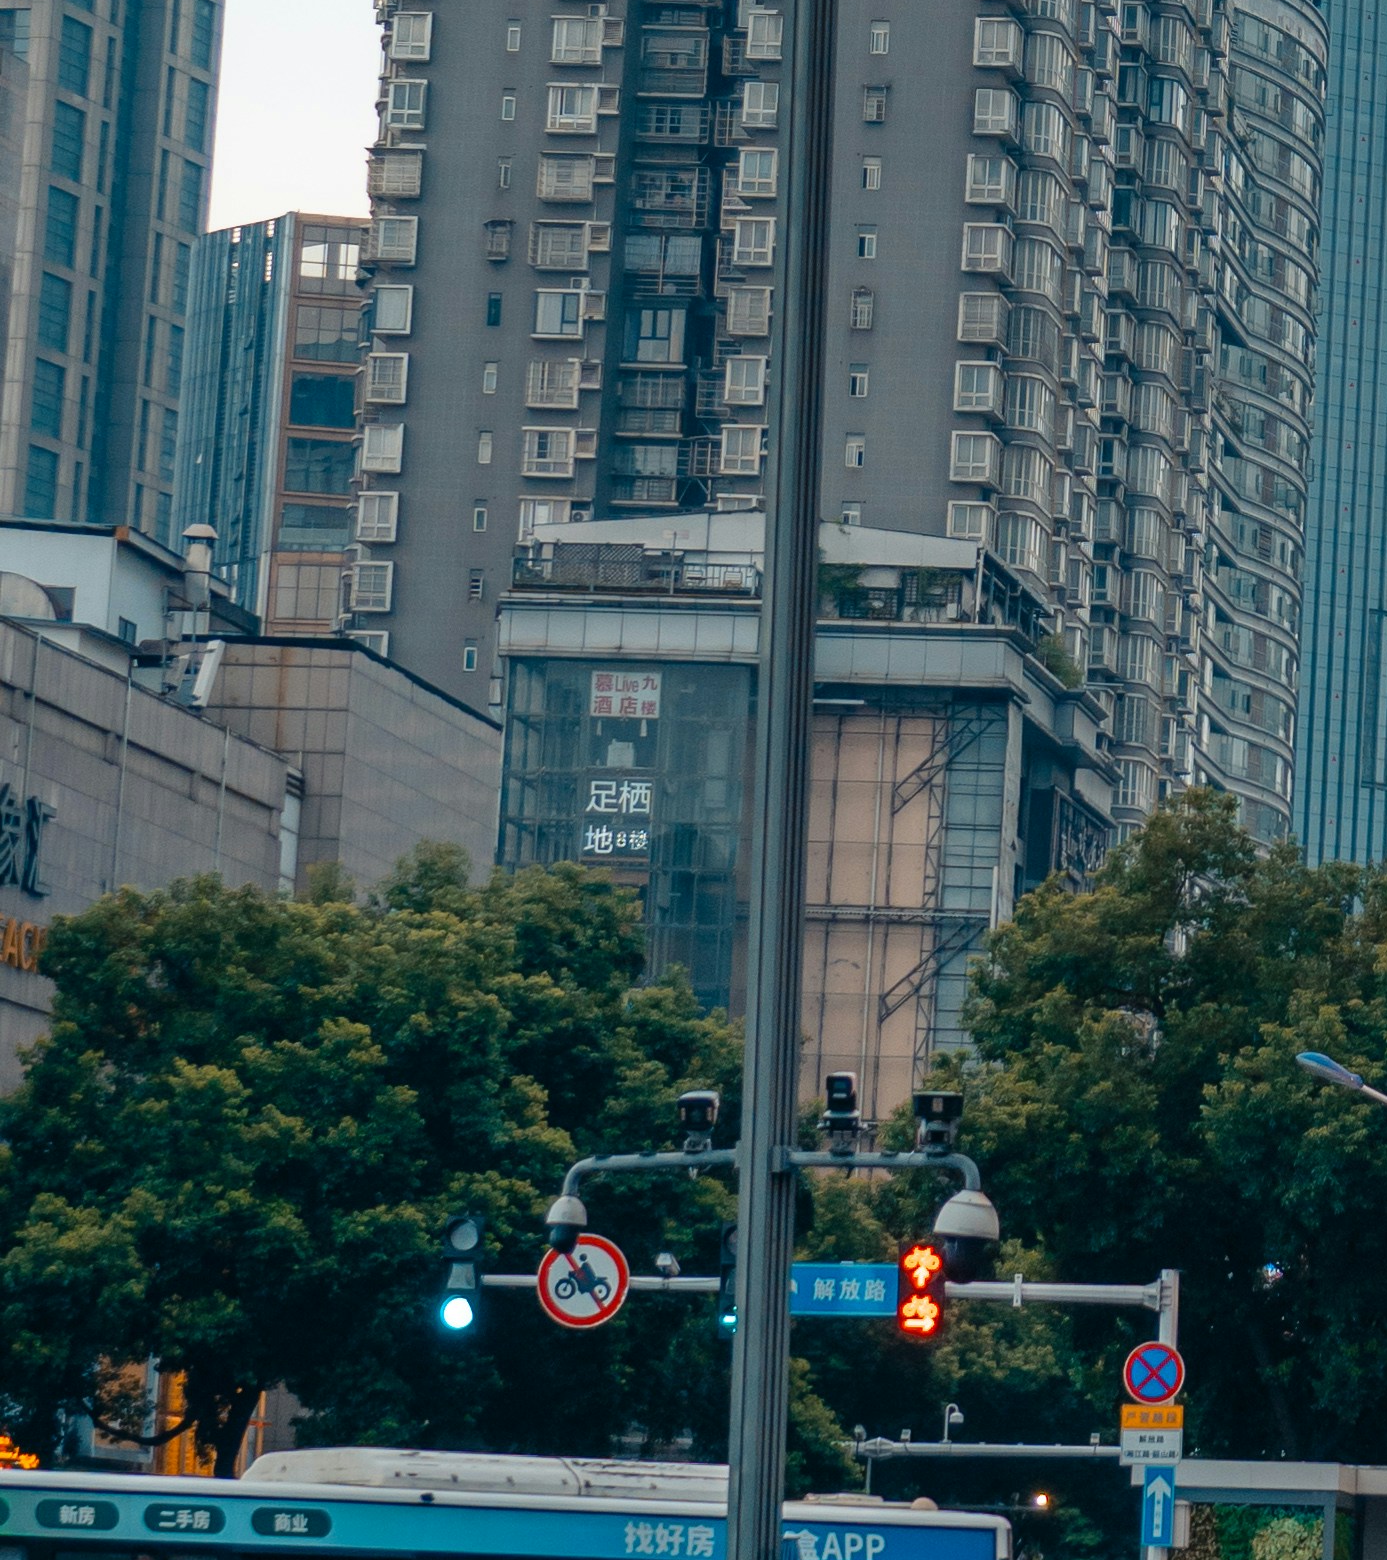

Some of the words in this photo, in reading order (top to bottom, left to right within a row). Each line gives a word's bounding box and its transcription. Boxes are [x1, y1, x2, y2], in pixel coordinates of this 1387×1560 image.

[585, 780, 653, 815] 足栖
[812, 1277, 887, 1302] 解放路
[58, 1503, 96, 1527] 新房
[158, 1509, 211, 1531] 二手房
[273, 1512, 309, 1534] 商业
[624, 1520, 716, 1558] 找好房
